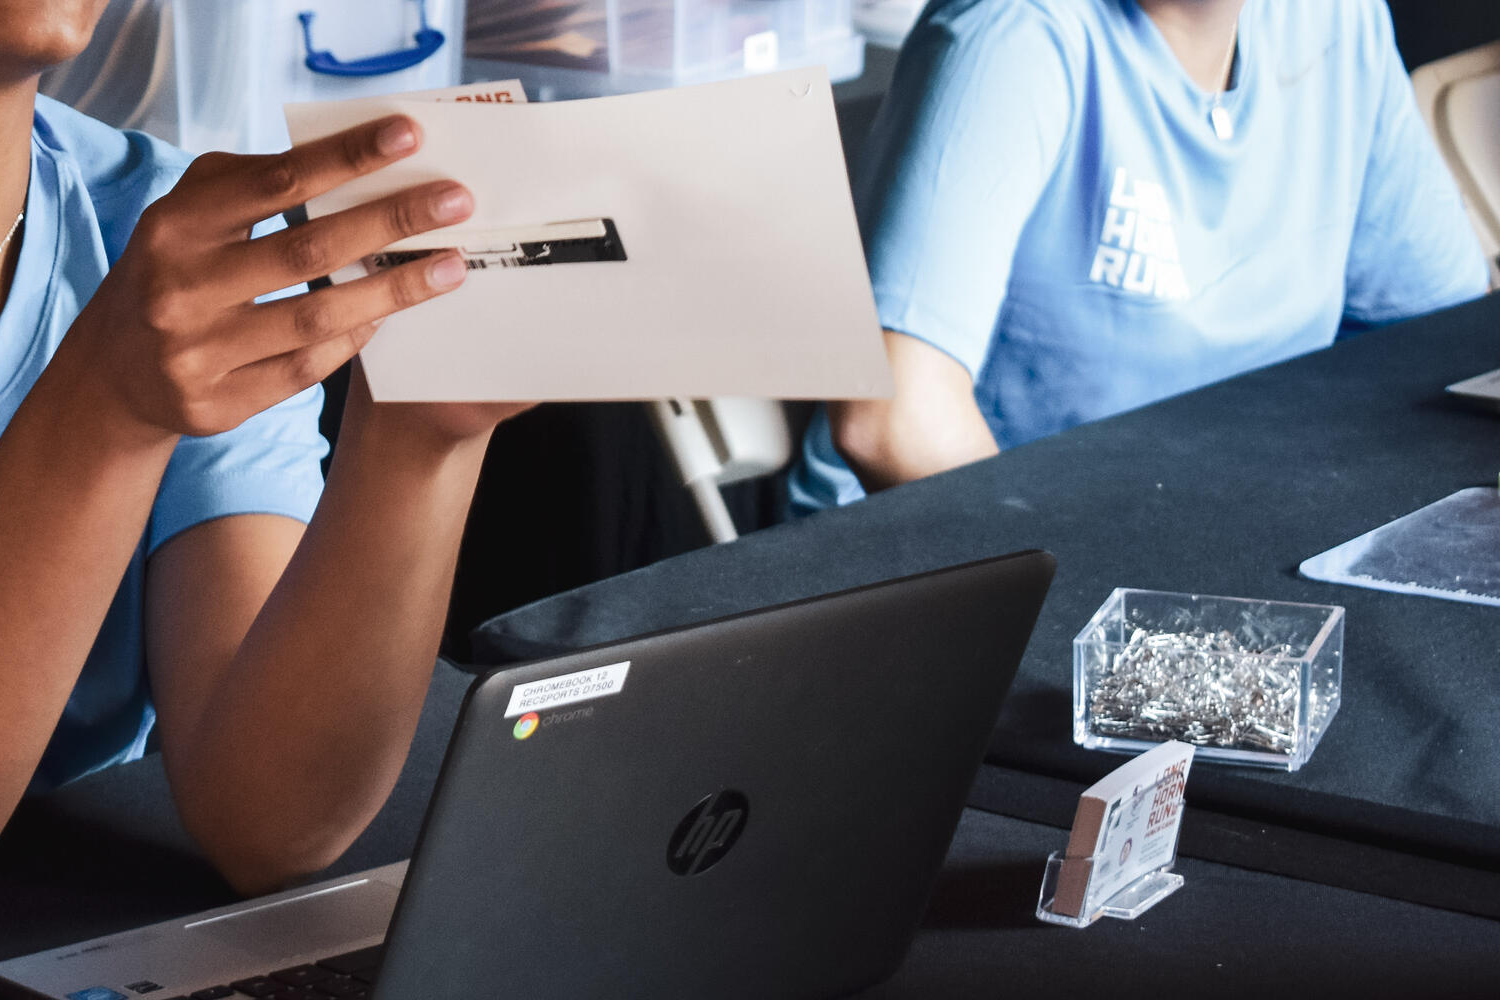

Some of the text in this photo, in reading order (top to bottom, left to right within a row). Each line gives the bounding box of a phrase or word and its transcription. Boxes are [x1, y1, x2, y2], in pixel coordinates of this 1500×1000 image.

[523, 671, 608, 697] CHROMEBOOK 12
[541, 706, 594, 727] chrome
[666, 789, 750, 876] hp
